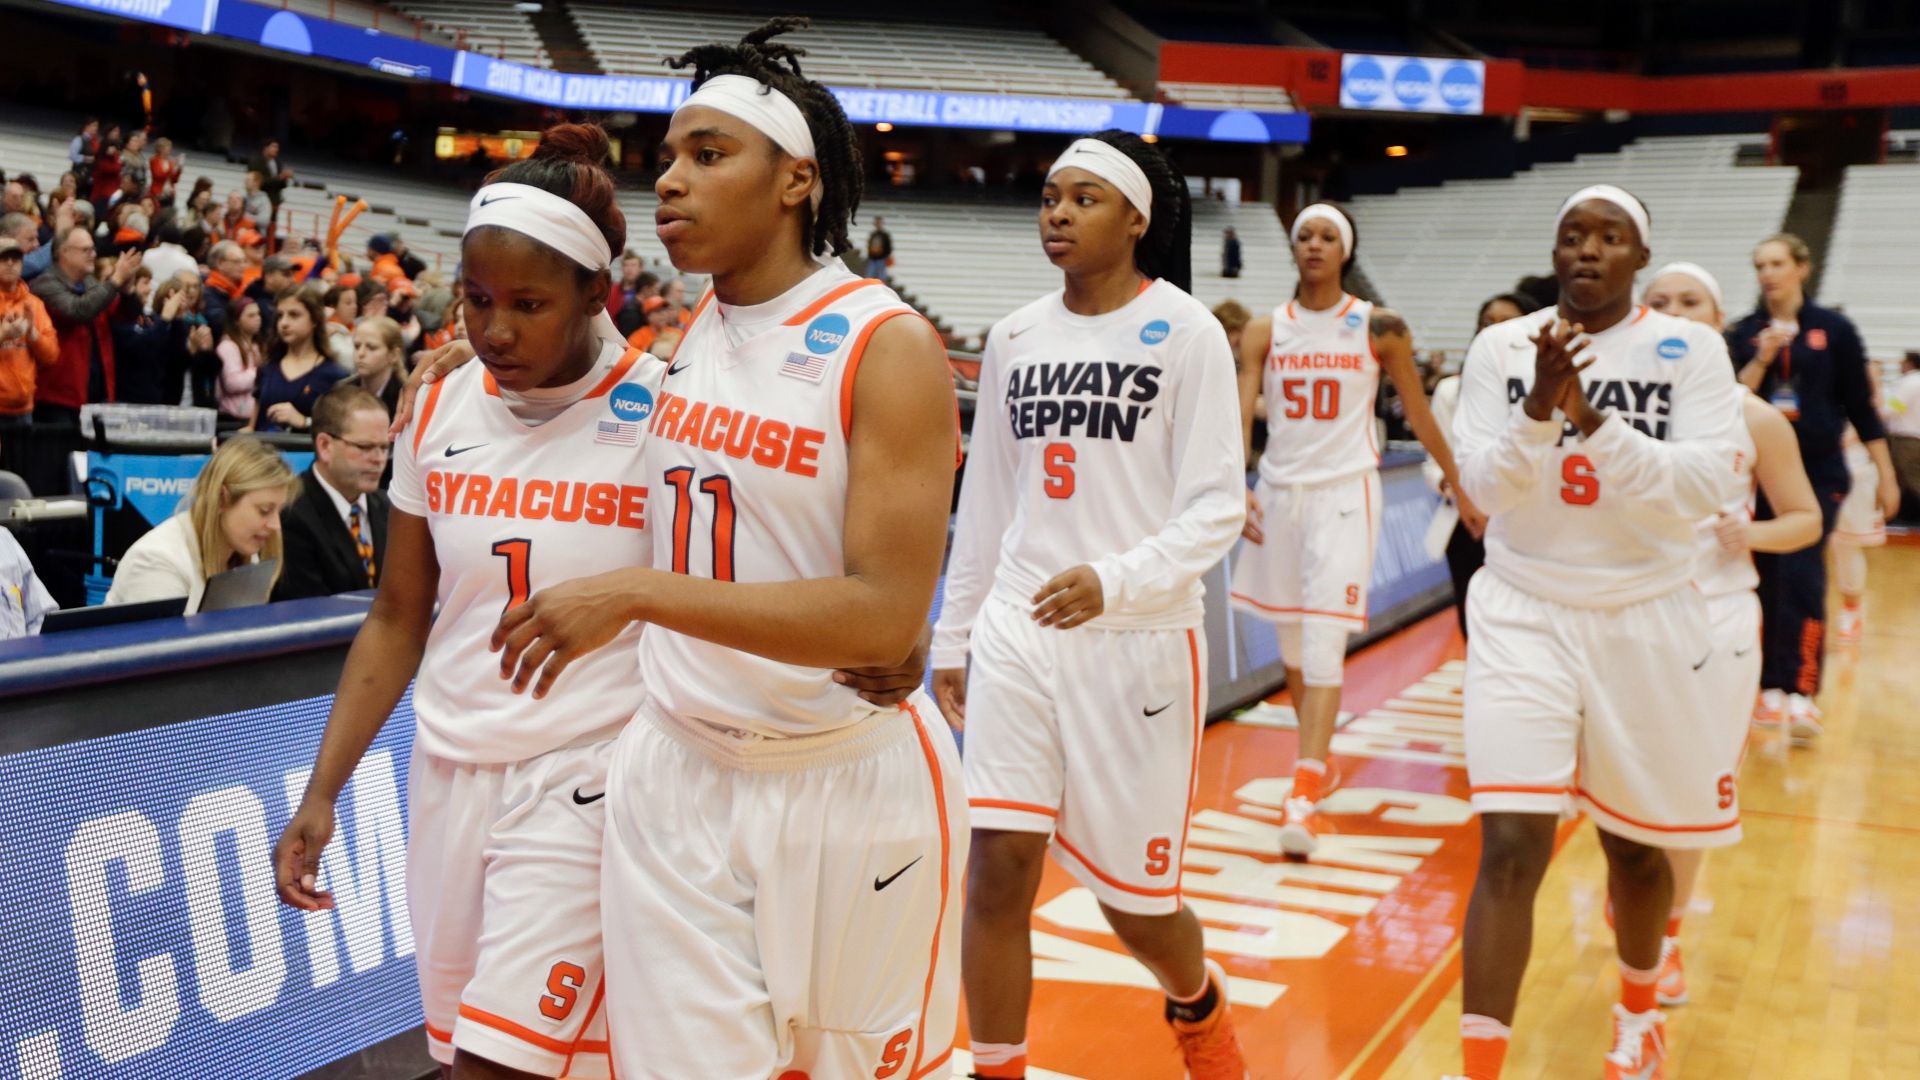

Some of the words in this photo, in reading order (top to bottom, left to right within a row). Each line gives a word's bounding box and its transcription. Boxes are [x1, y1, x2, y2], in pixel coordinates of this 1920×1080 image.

[565, 79, 669, 107] DIVISION
[941, 96, 1112, 130] CHAMPIONSHIP
[811, 329, 843, 345] NCAA
[614, 398, 650, 414] NCAA
[1005, 361, 1163, 405] ALWAYS
[1282, 378, 1341, 420] 50
[649, 390, 826, 478] YRACUSE
[1043, 442, 1076, 499] S
[1560, 454, 1600, 506] S
[425, 470, 649, 530] SYRACUSE
[663, 465, 737, 583] 11
[491, 537, 532, 616] 1
[1716, 774, 1735, 810] S
[1145, 837, 1172, 876] S
[538, 960, 586, 1021] S
[874, 1028, 913, 1080] S
